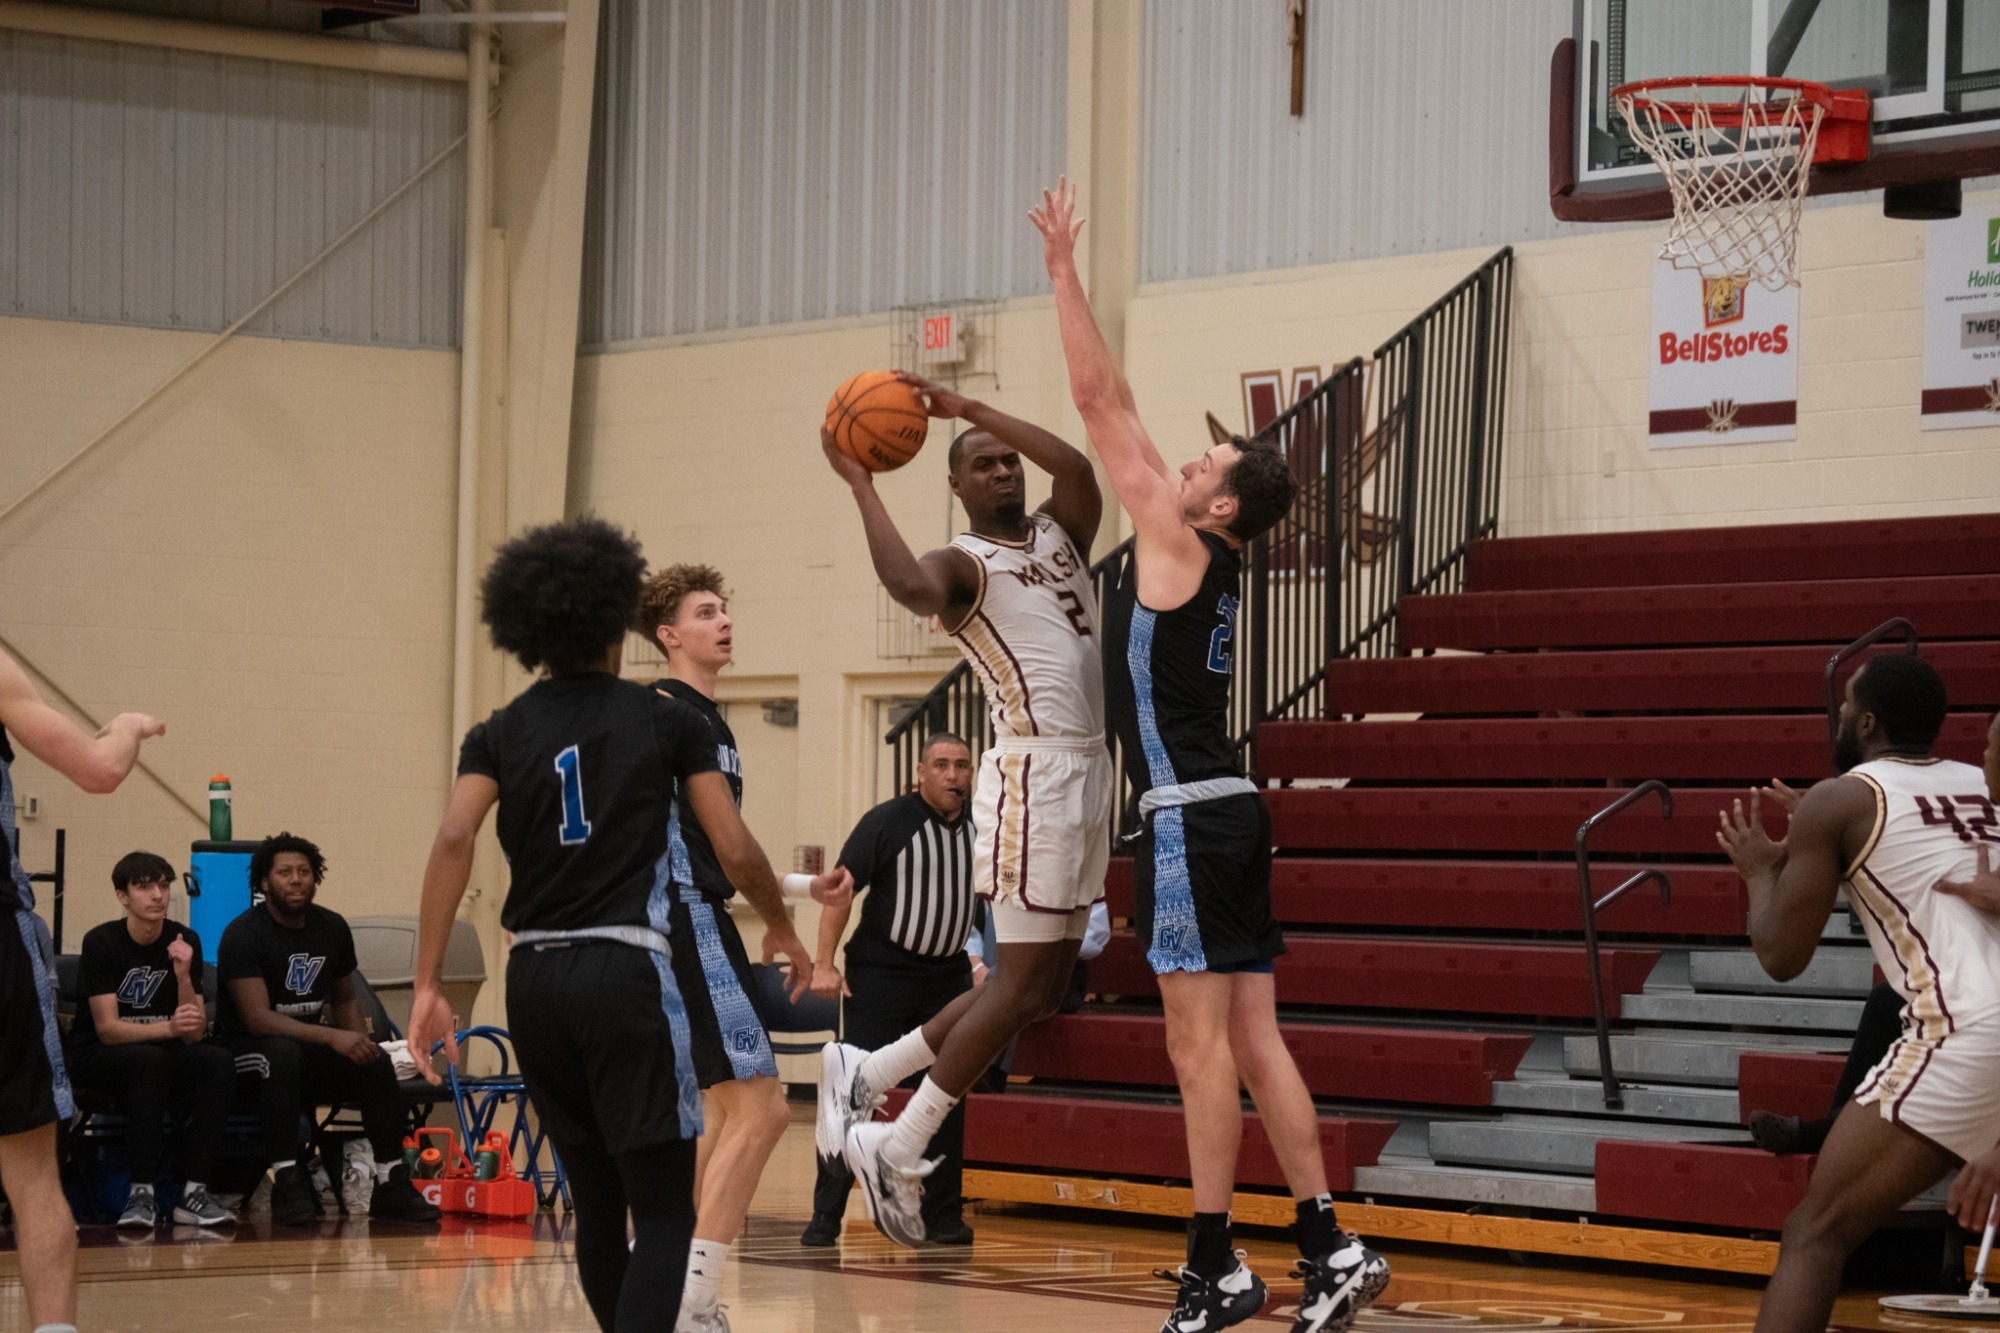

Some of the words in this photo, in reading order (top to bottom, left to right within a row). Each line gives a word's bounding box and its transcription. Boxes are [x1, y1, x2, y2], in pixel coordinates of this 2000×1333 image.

[924, 317, 951, 350] EXIT
[1056, 590, 1093, 637] 2
[554, 743, 592, 846] 1
[1913, 794, 2000, 844] 42
[1158, 925, 1188, 955] GV
[732, 1026, 762, 1056] GV
[422, 1184, 442, 1206] G
[465, 1186, 476, 1208] G
